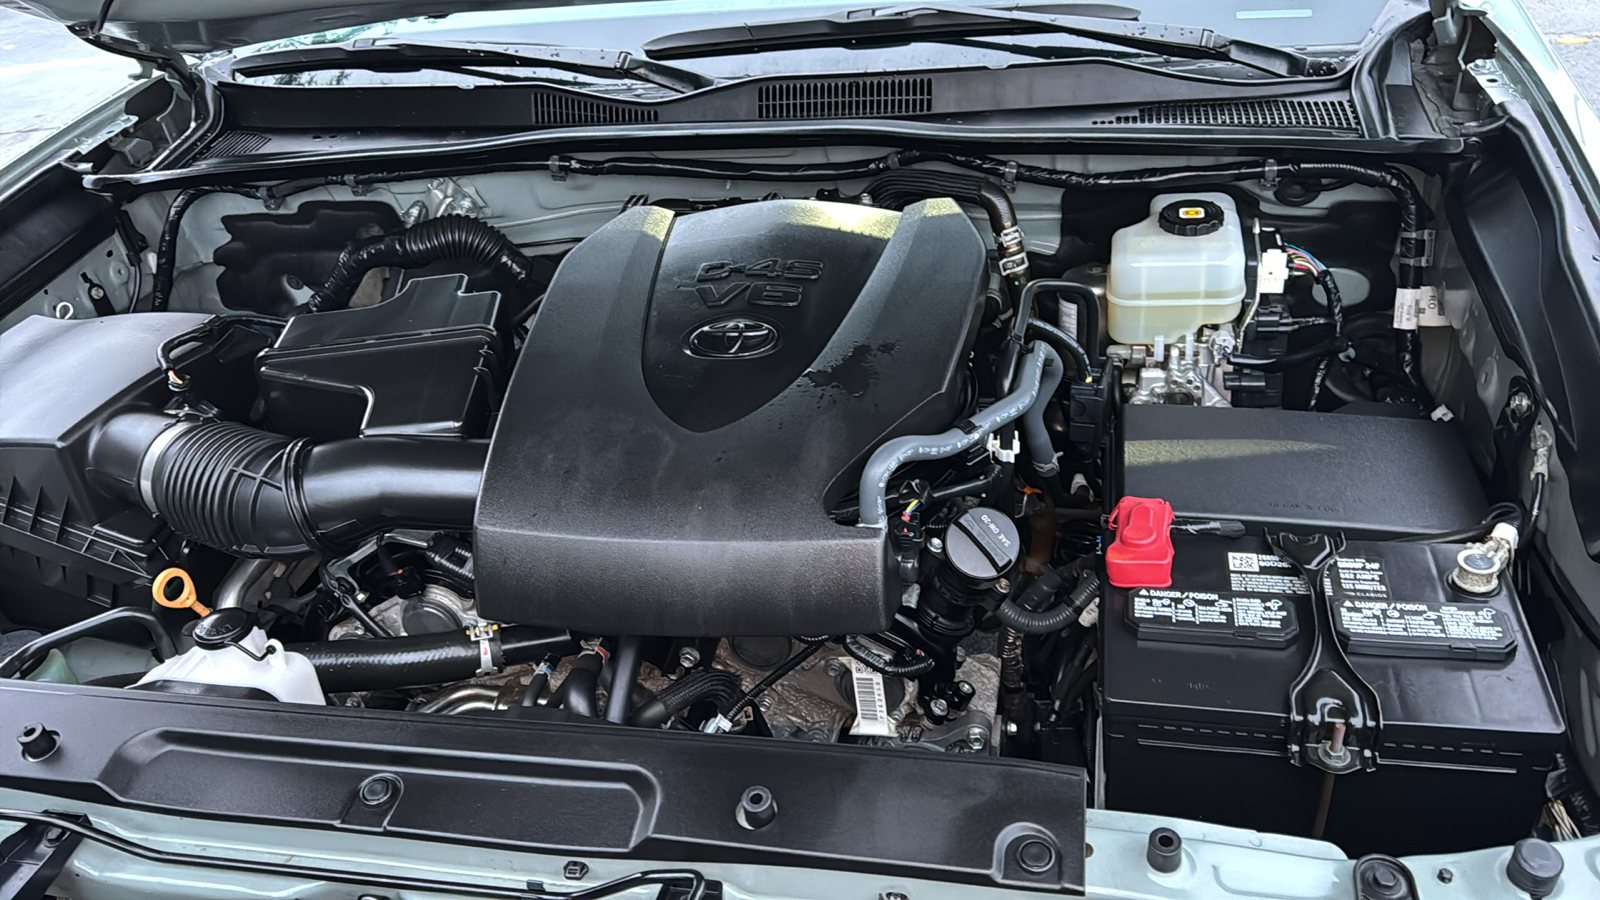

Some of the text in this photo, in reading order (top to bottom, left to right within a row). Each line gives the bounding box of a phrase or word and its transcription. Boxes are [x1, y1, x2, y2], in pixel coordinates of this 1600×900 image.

[694, 258, 824, 281] D-4S
[694, 282, 803, 306] V6
[981, 514, 1012, 547] SAE 0W-20
[1356, 573, 1380, 581] AMPS
[1149, 589, 1182, 598] DANGER
[1188, 592, 1219, 600] POISON
[1354, 600, 1388, 610] DANGER
[1395, 602, 1428, 612] POISON
